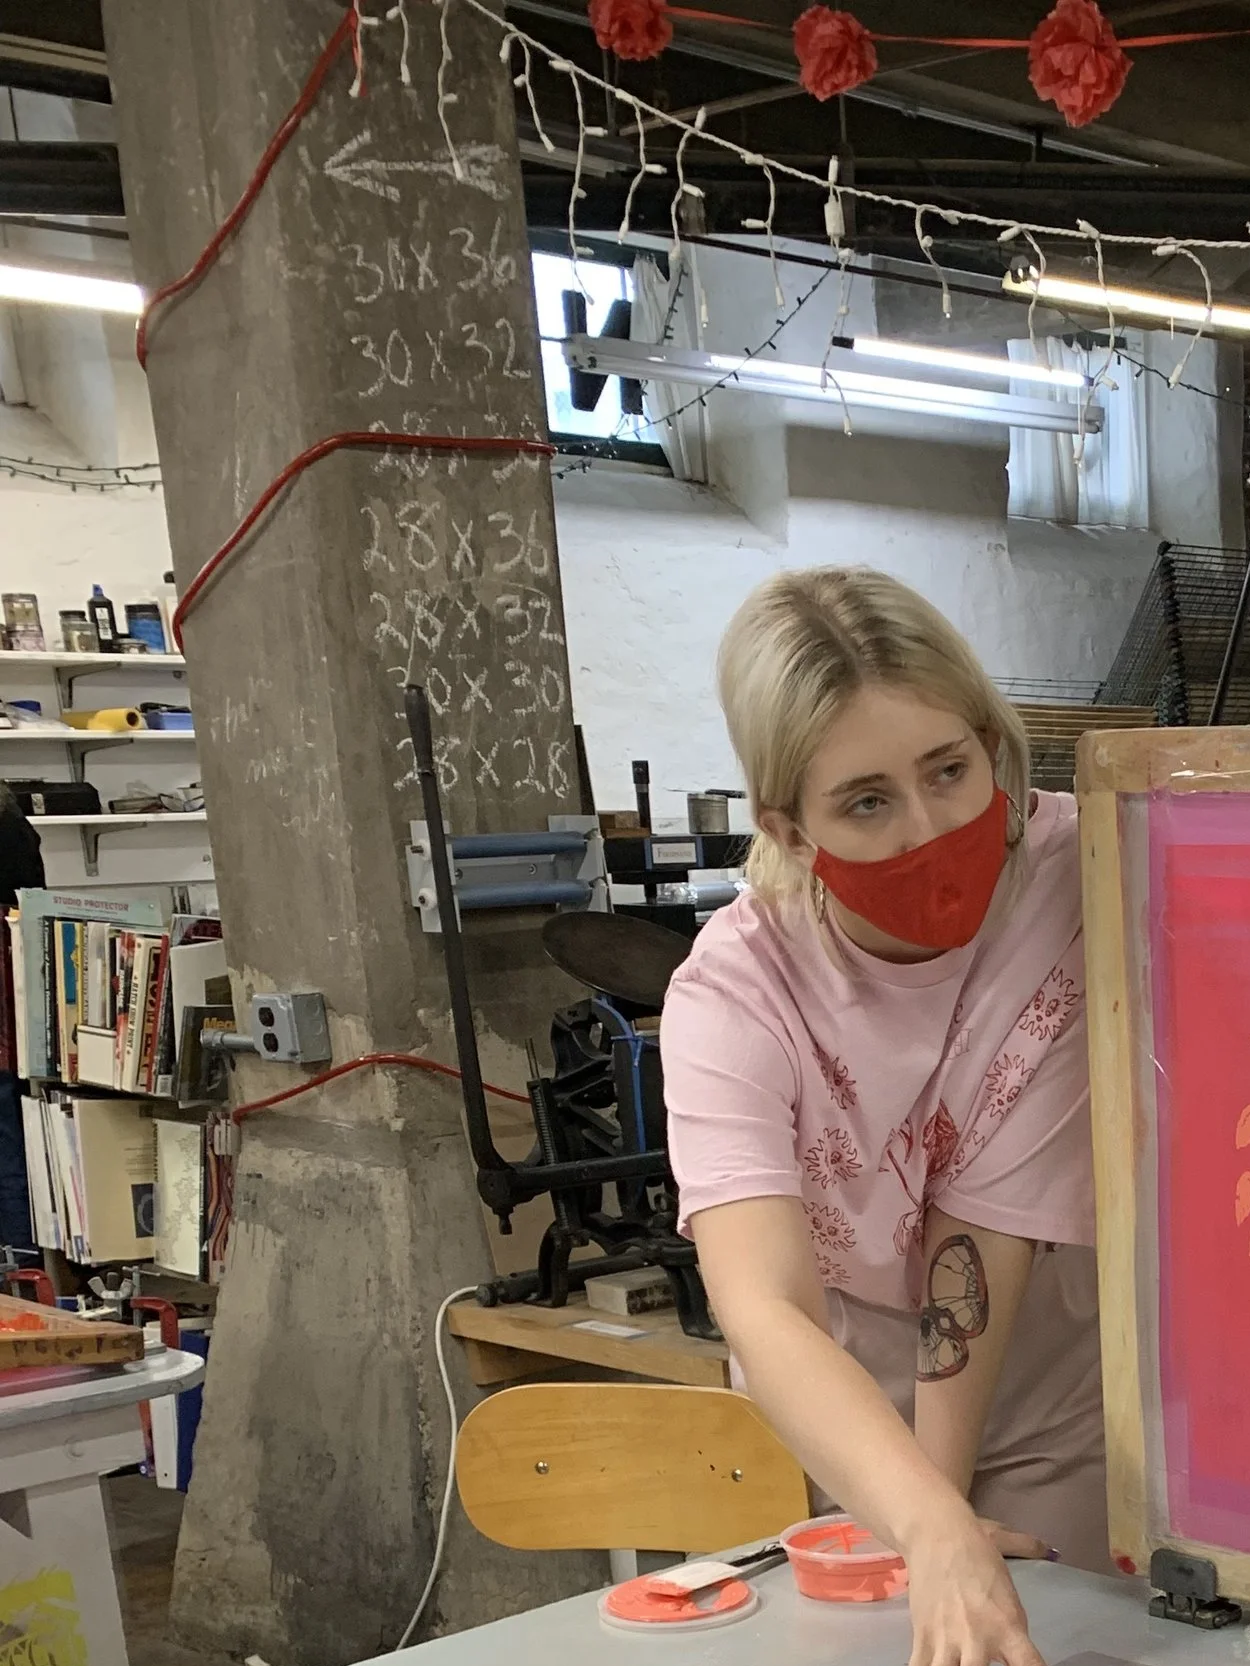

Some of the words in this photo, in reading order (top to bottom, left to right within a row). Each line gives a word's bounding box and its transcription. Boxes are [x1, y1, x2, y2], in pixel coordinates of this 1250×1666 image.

[448, 215, 517, 293] 36
[350, 328, 413, 398] 30
[461, 317, 532, 382] 32
[360, 499, 441, 573] 28
[487, 509, 549, 577] 36
[369, 590, 446, 651] 28
[496, 594, 564, 646] 32
[503, 660, 566, 717] 30
[52, 896, 83, 907] STUDIO
[83, 899, 129, 912] PROTECTOR
[129, 982, 139, 1006] HATCH
[126, 1027, 135, 1050] PRINT
